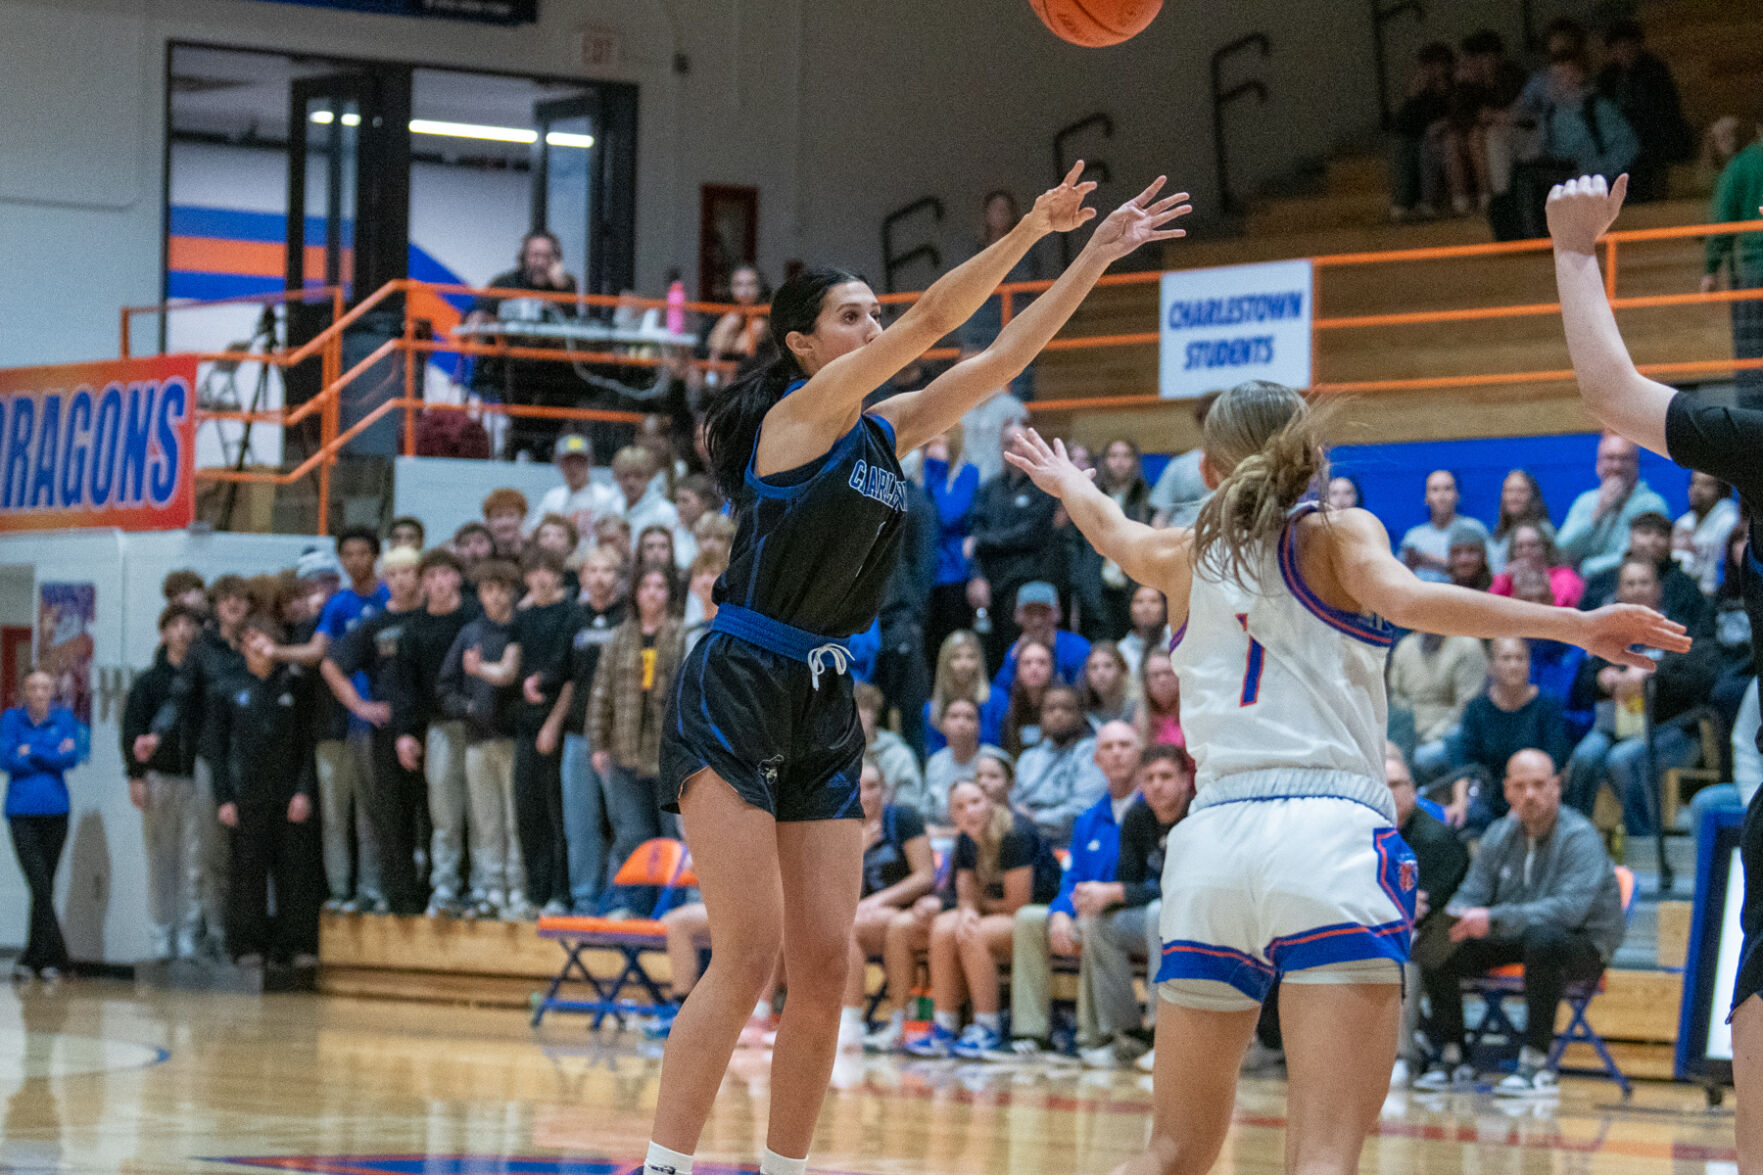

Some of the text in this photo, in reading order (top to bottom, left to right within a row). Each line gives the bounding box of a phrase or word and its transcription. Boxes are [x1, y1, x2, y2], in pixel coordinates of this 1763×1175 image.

[1169, 290, 1303, 330] CHARLESTOWN
[1184, 334, 1275, 371] STUDENTS
[0, 381, 188, 510] RAGONS
[1234, 613, 1267, 708] 1
